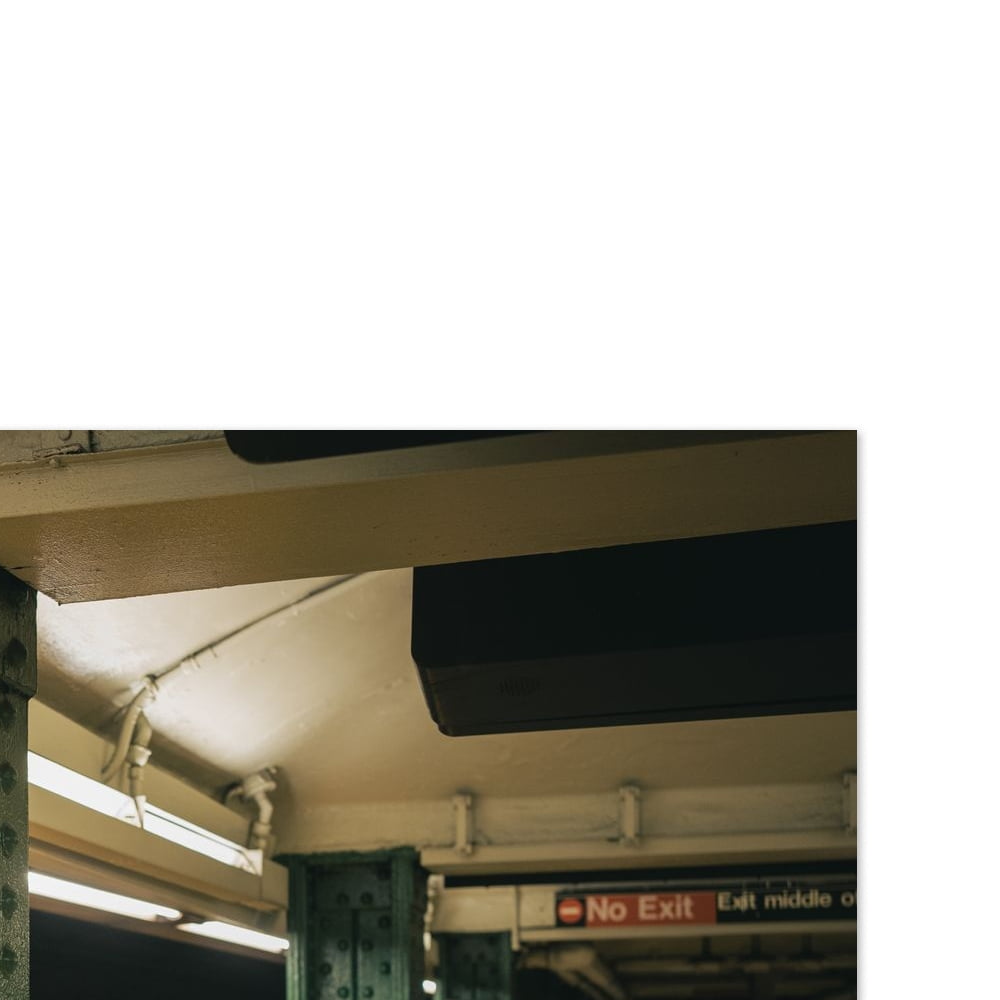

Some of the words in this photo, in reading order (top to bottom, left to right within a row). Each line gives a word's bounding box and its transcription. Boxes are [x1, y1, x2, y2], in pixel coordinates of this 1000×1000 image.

[586, 895, 627, 922] No
[638, 894, 694, 921] Exit
[717, 891, 756, 911] Exit
[764, 888, 832, 909] middle
[841, 889, 857, 908] o
